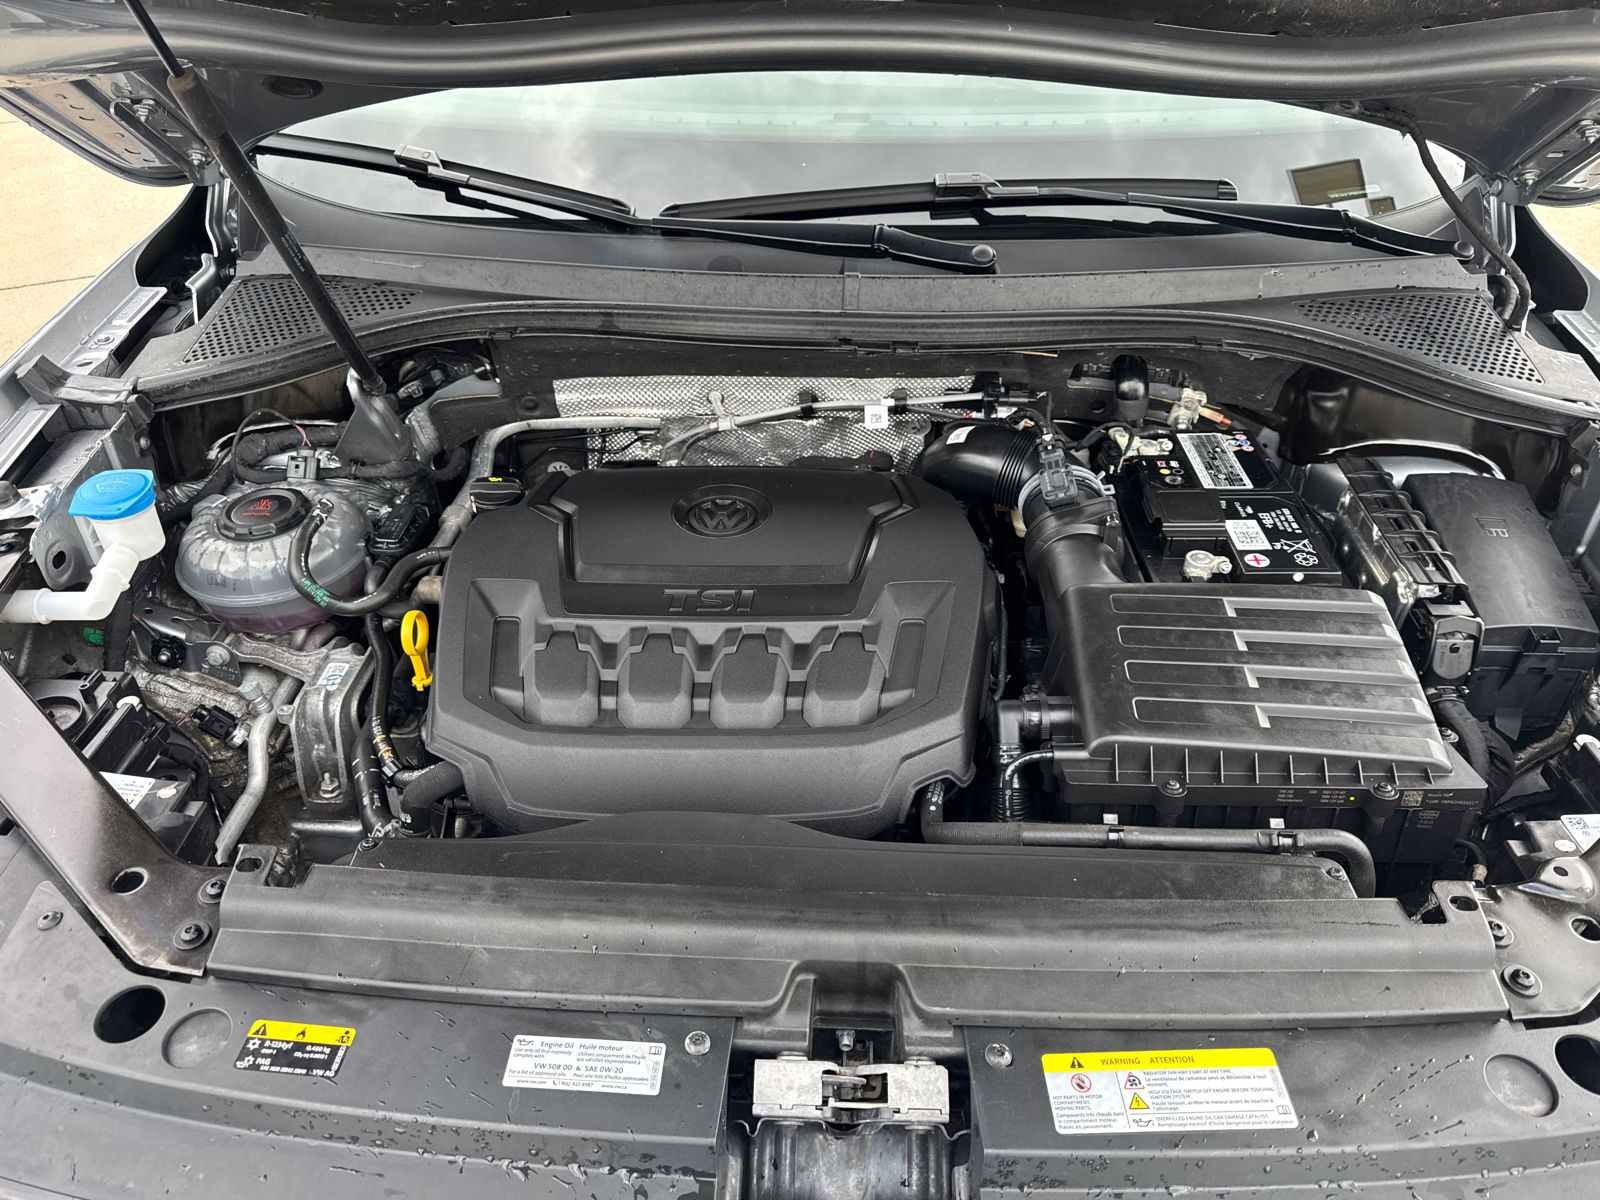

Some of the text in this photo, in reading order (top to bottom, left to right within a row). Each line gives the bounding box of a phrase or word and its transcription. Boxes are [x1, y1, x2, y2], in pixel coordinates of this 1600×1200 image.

[1258, 512, 1274, 528] EFB+
[662, 588, 756, 612] TSI
[264, 1040, 294, 1050] R-1234yf
[541, 1041, 563, 1049] Engine
